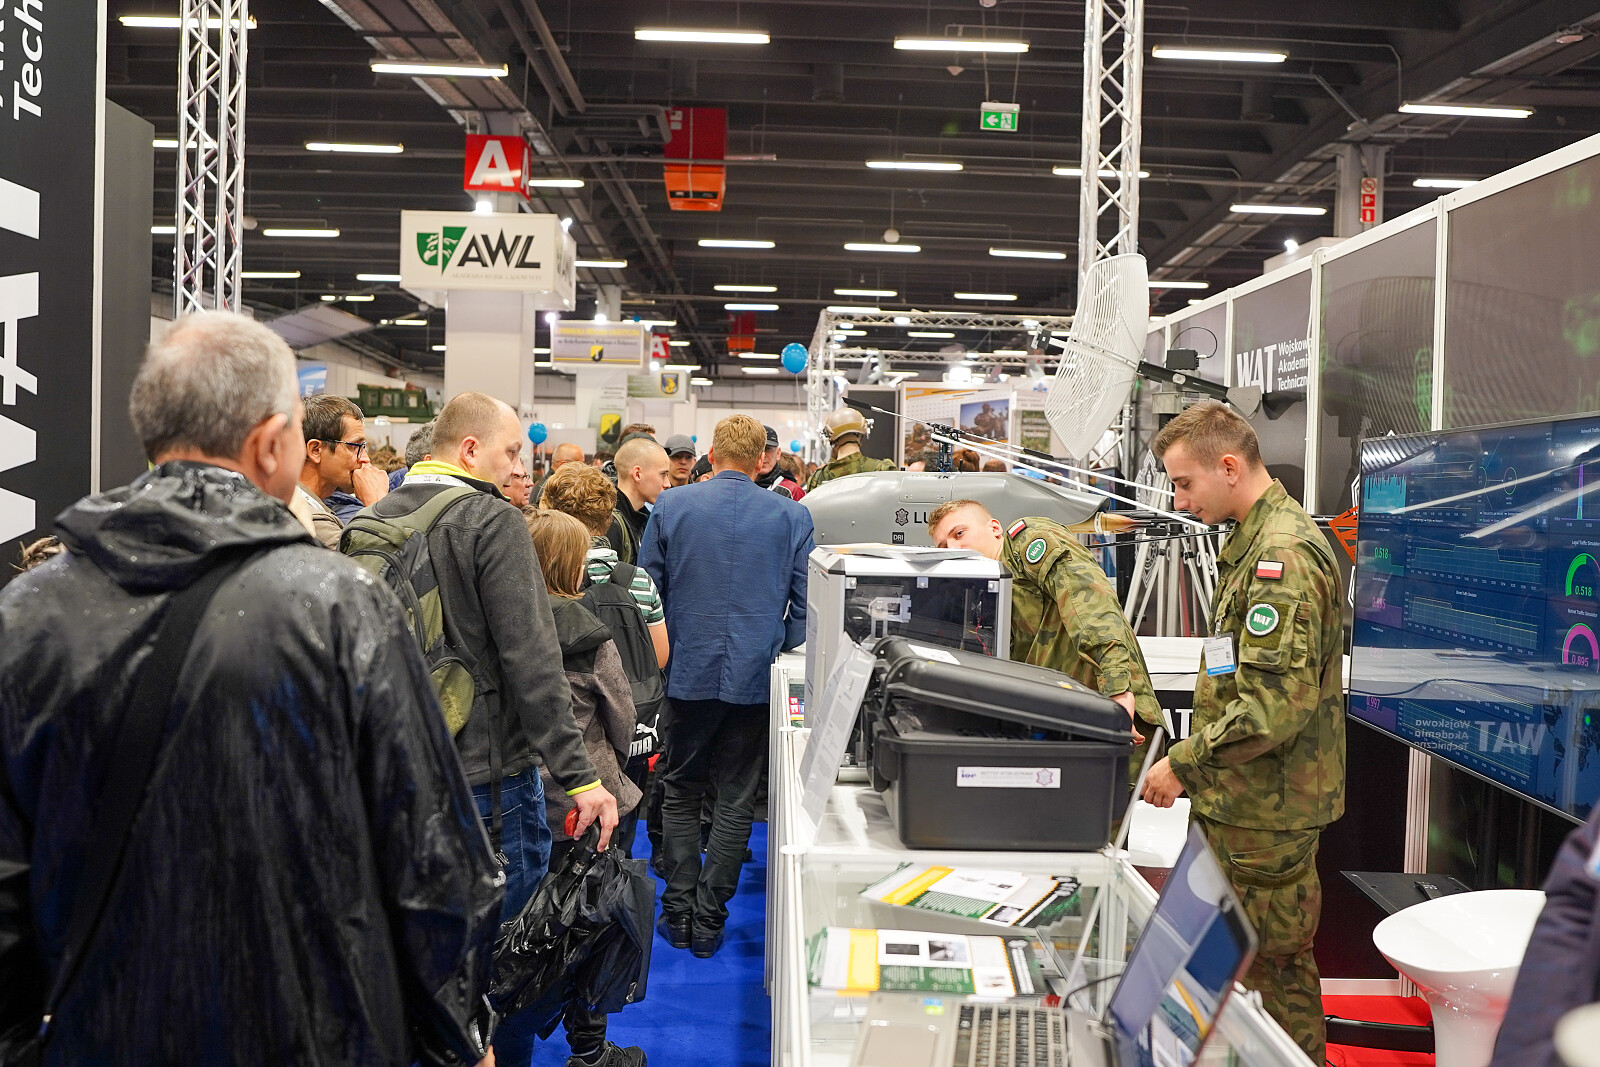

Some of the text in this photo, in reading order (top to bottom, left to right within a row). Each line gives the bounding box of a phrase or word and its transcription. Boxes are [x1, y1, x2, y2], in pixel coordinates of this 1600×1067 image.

[469, 140, 515, 187] A
[520, 147, 530, 196] A
[457, 228, 541, 269] AWL
[652, 335, 666, 357] A
[1237, 344, 1277, 394] WAT
[1277, 354, 1309, 374] Akademi
[1277, 374, 1309, 391] Techniczn
[1030, 543, 1042, 557] WAT
[1374, 547, 1389, 560] 0.518
[1575, 585, 1592, 597] 0.518
[1253, 612, 1273, 626] WAT
[1571, 654, 1589, 667] 0.895
